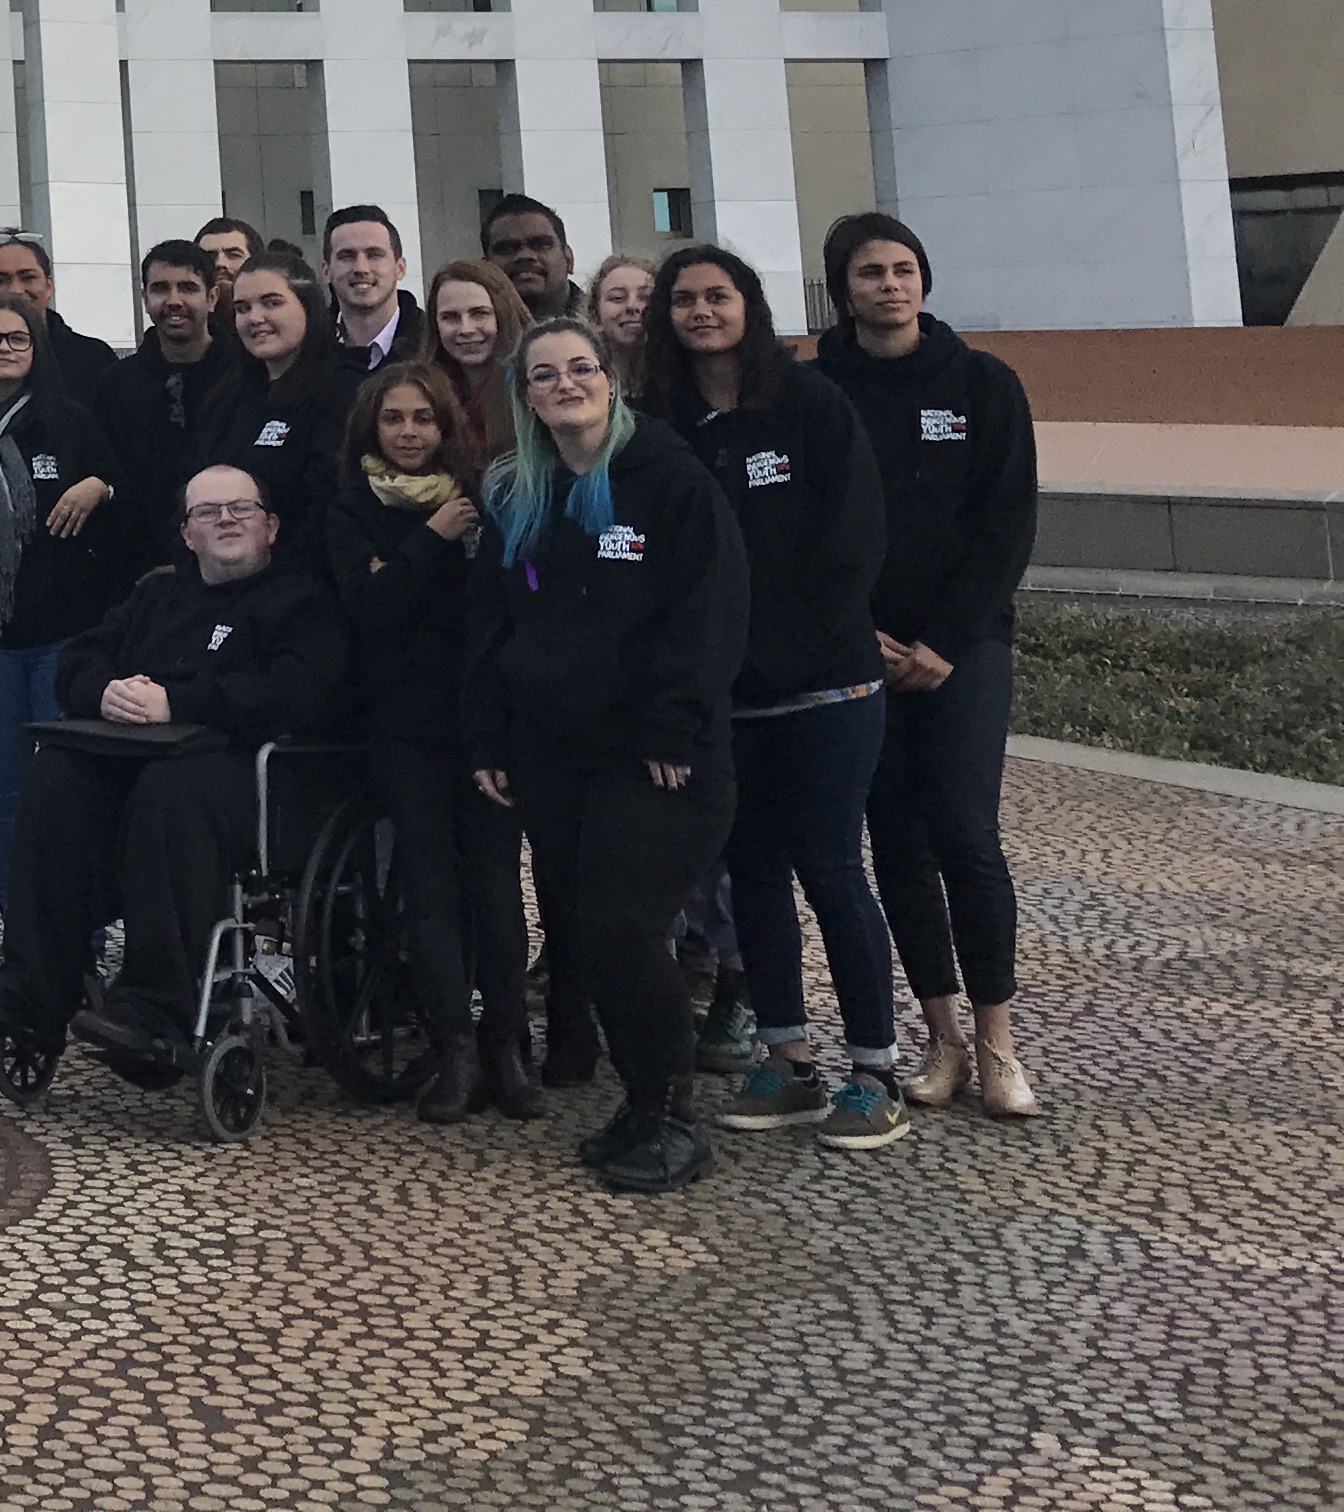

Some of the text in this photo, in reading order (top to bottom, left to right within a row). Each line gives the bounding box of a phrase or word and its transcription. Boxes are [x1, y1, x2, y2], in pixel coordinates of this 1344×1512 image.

[921, 423, 952, 434] YOUTH
[921, 432, 966, 441] PARLIAMENT
[747, 467, 777, 480] YOUTH
[749, 473, 791, 488] PARLIAMENT
[599, 539, 630, 551] YOUTH
[597, 550, 643, 561] PARLIAMENT
